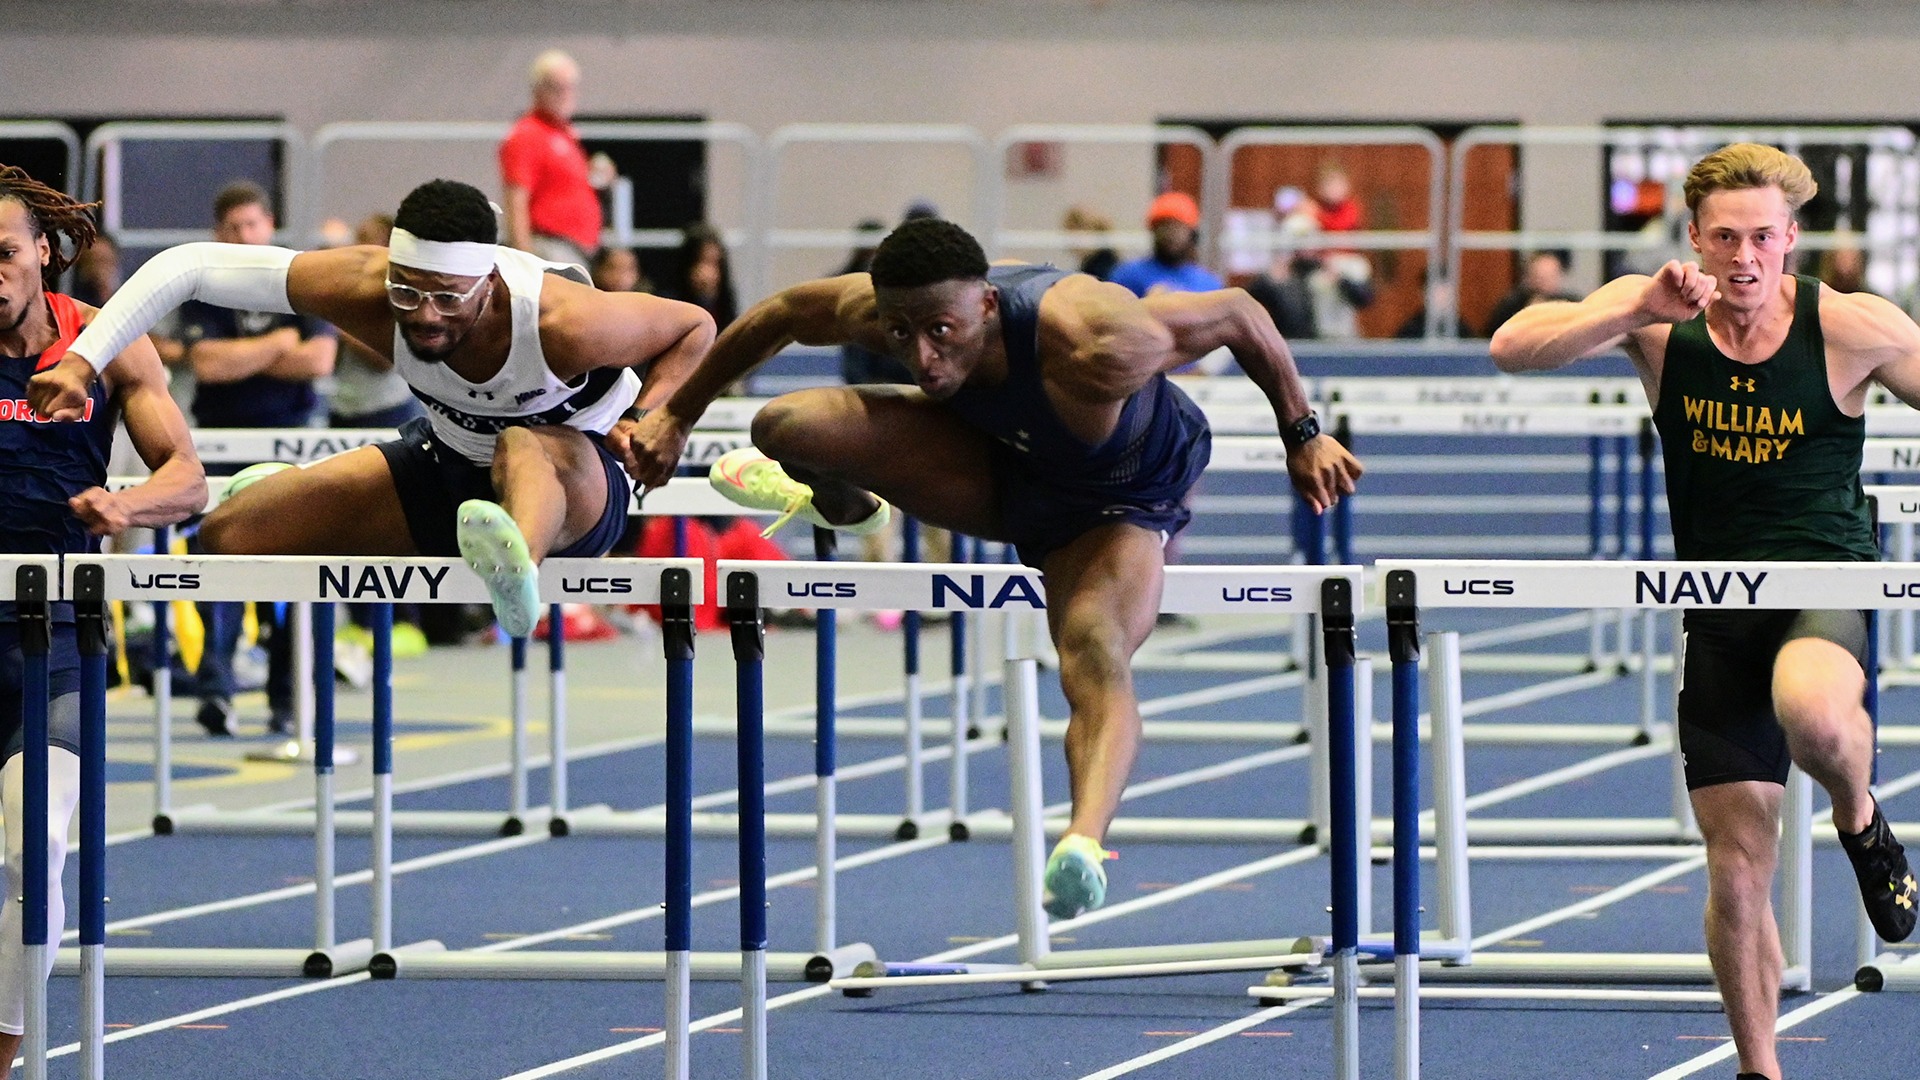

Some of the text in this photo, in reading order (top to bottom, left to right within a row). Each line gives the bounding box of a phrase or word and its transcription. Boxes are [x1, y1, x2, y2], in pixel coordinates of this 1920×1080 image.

[1683, 395, 1805, 435] WILLIAM
[274, 438, 384, 459] NAV
[1692, 429, 1791, 464] &MARY
[1892, 448, 1920, 468] N
[131, 565, 632, 599] UCS NAVY UCS
[787, 574, 1293, 609] UCS NA UCS
[1444, 579, 1515, 595] UCS
[1635, 571, 1768, 604] NAVY
